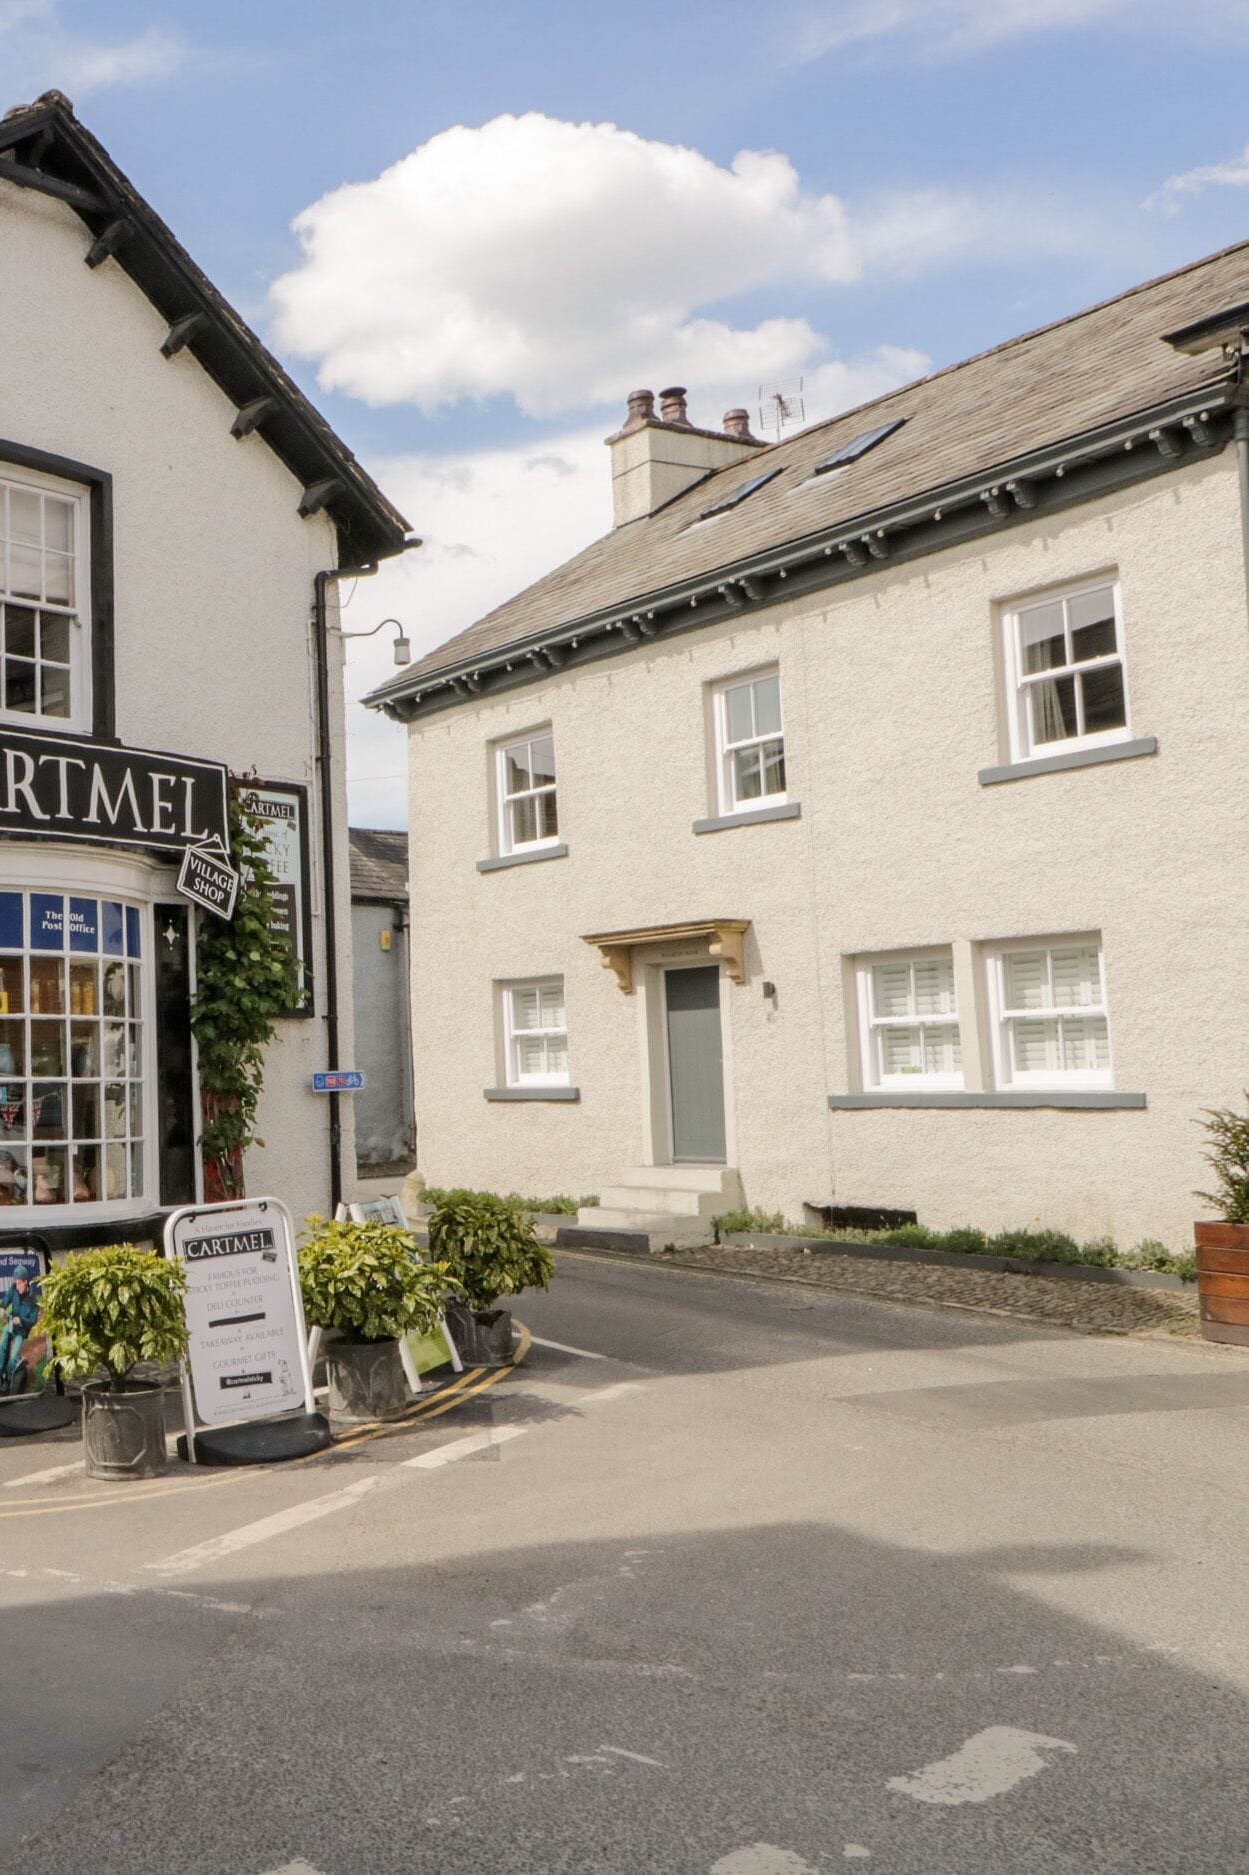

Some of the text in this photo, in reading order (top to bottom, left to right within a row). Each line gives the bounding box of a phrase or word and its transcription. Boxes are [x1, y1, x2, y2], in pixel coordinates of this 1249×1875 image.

[191, 856, 233, 892] VILLAGE
[193, 878, 225, 903] SHOP
[45, 910, 84, 922] The Old
[42, 921, 95, 934] Post Office
